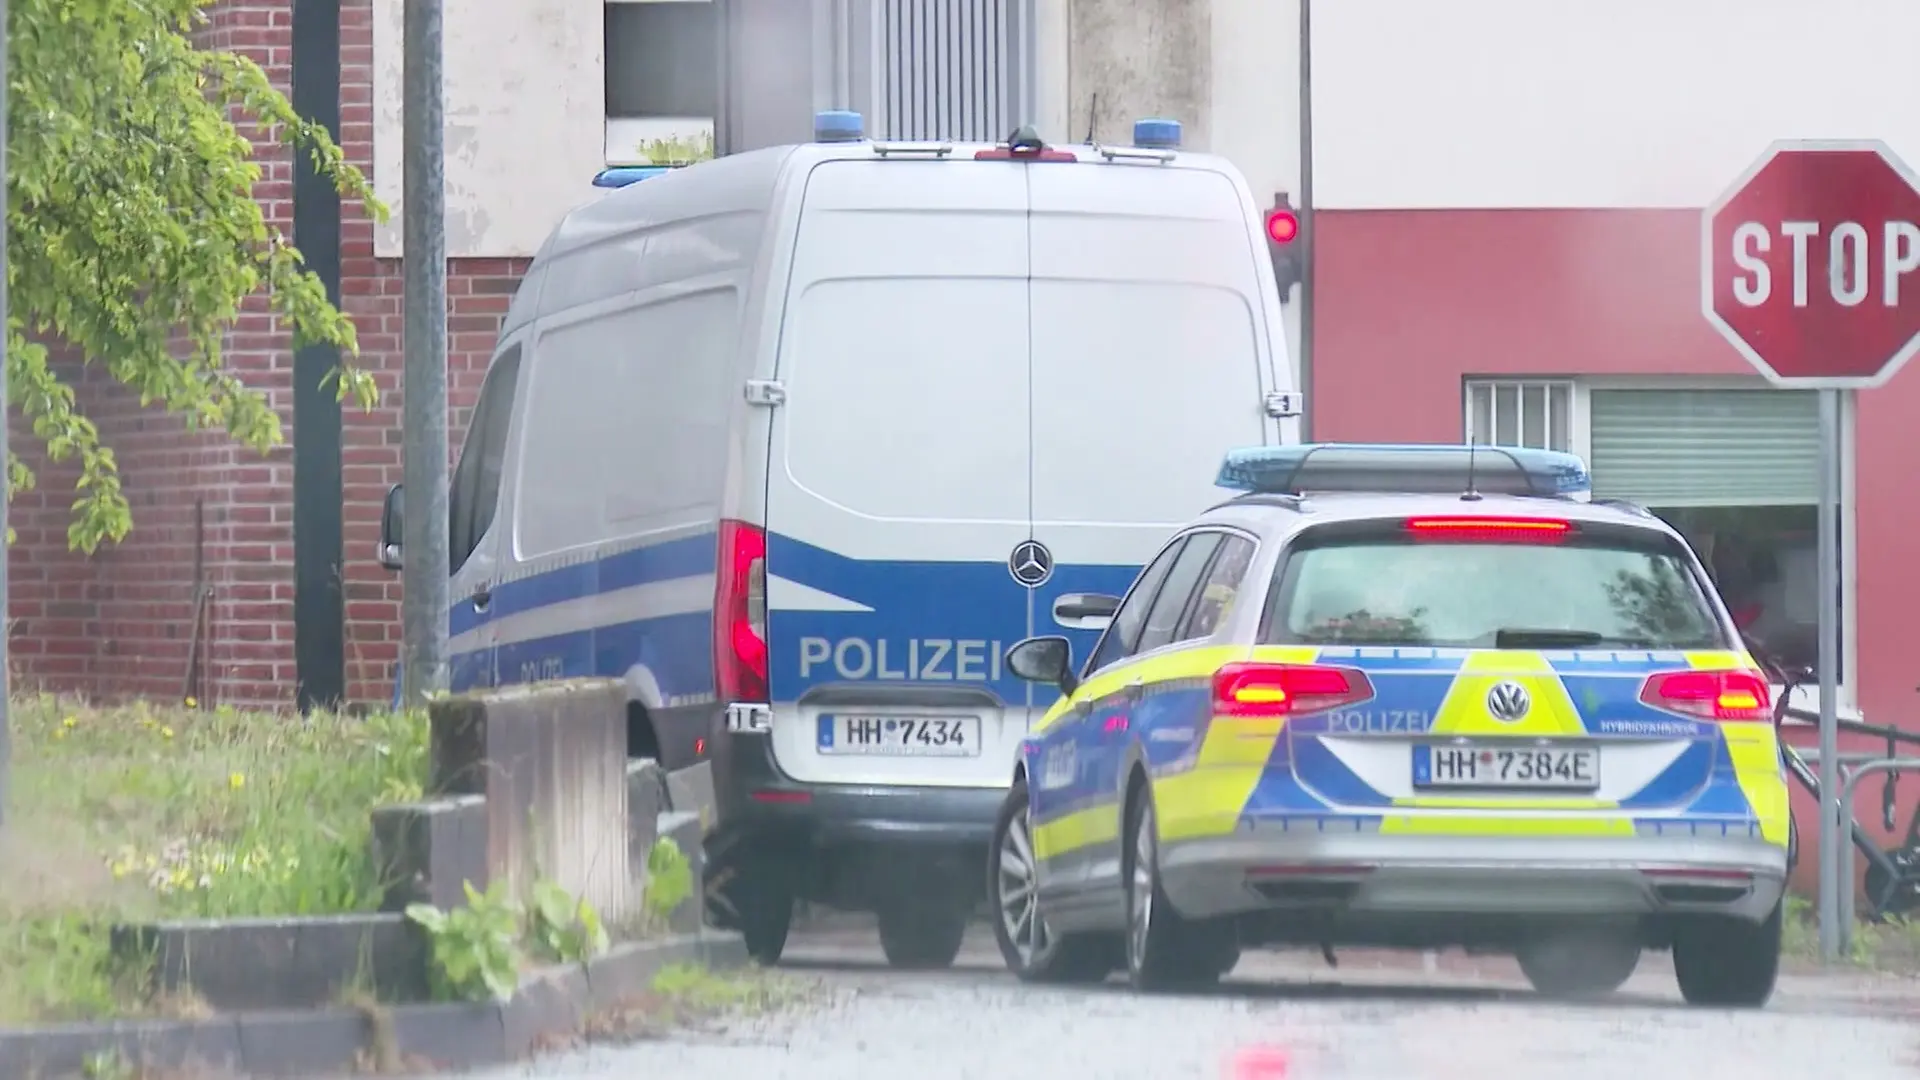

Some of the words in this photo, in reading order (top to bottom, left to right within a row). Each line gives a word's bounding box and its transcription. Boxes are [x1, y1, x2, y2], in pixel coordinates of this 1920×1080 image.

[1732, 221, 1920, 307] STOP
[800, 637, 999, 681] POLIZEI
[847, 719, 881, 744] HH
[900, 720, 964, 745] 7434
[1327, 709, 1429, 733] POLIZEI
[1436, 751, 1476, 778] HH
[1498, 752, 1592, 780] 7384E
